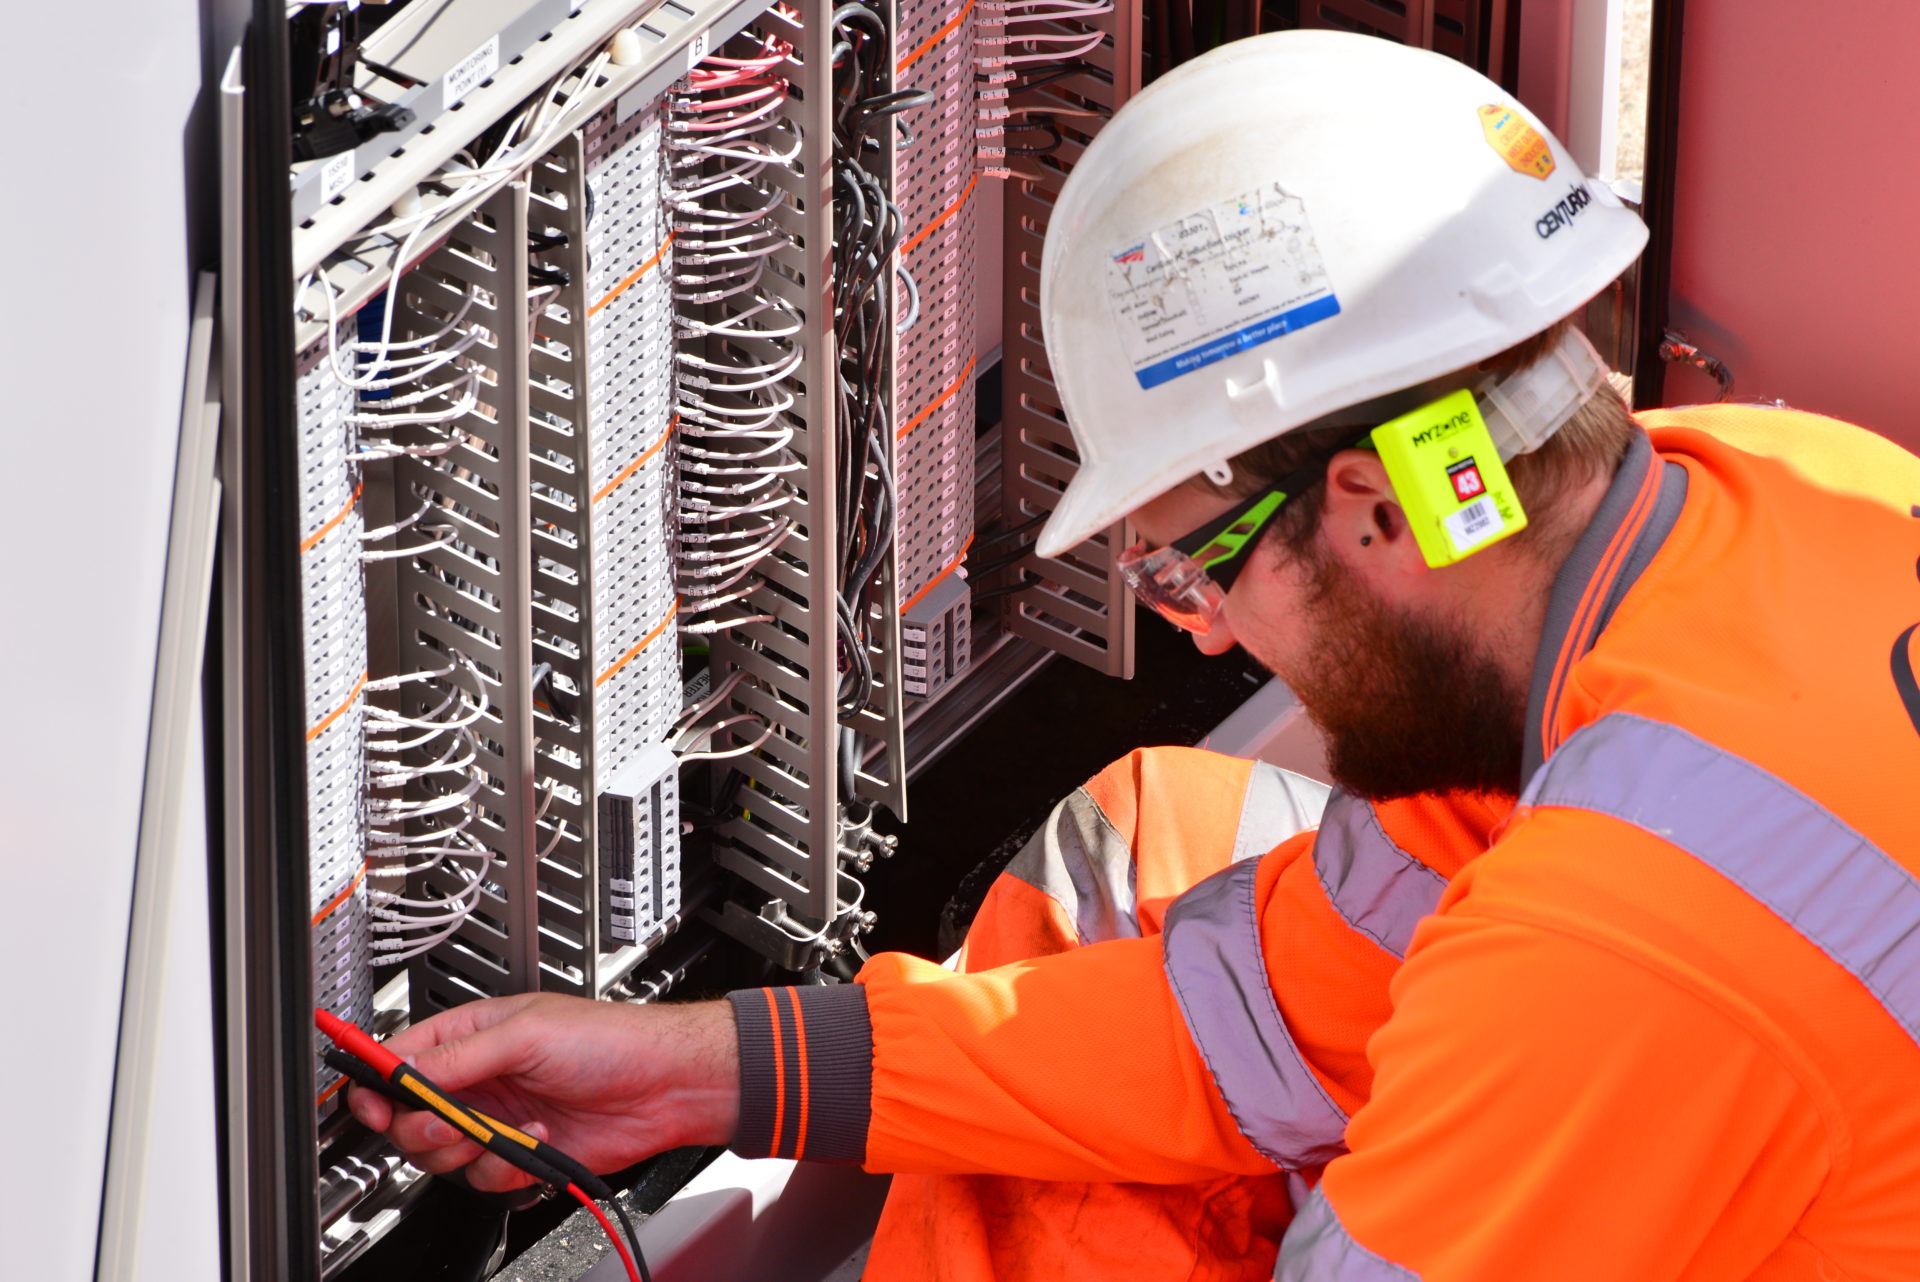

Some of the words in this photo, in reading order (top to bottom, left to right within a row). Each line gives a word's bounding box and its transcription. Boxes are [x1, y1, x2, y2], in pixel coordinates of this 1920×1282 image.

[695, 36, 703, 56] B
[985, 36, 1010, 45] C13
[448, 43, 494, 85] MONITORING
[983, 91, 1006, 101] C16
[1536, 184, 1592, 239] CENTURION
[1175, 351, 1201, 369] Making
[1200, 339, 1236, 361] tomorrow
[1235, 336, 1242, 347] a
[1242, 325, 1266, 344] better
[1266, 319, 1287, 340] place
[1456, 470, 1480, 495] 43
